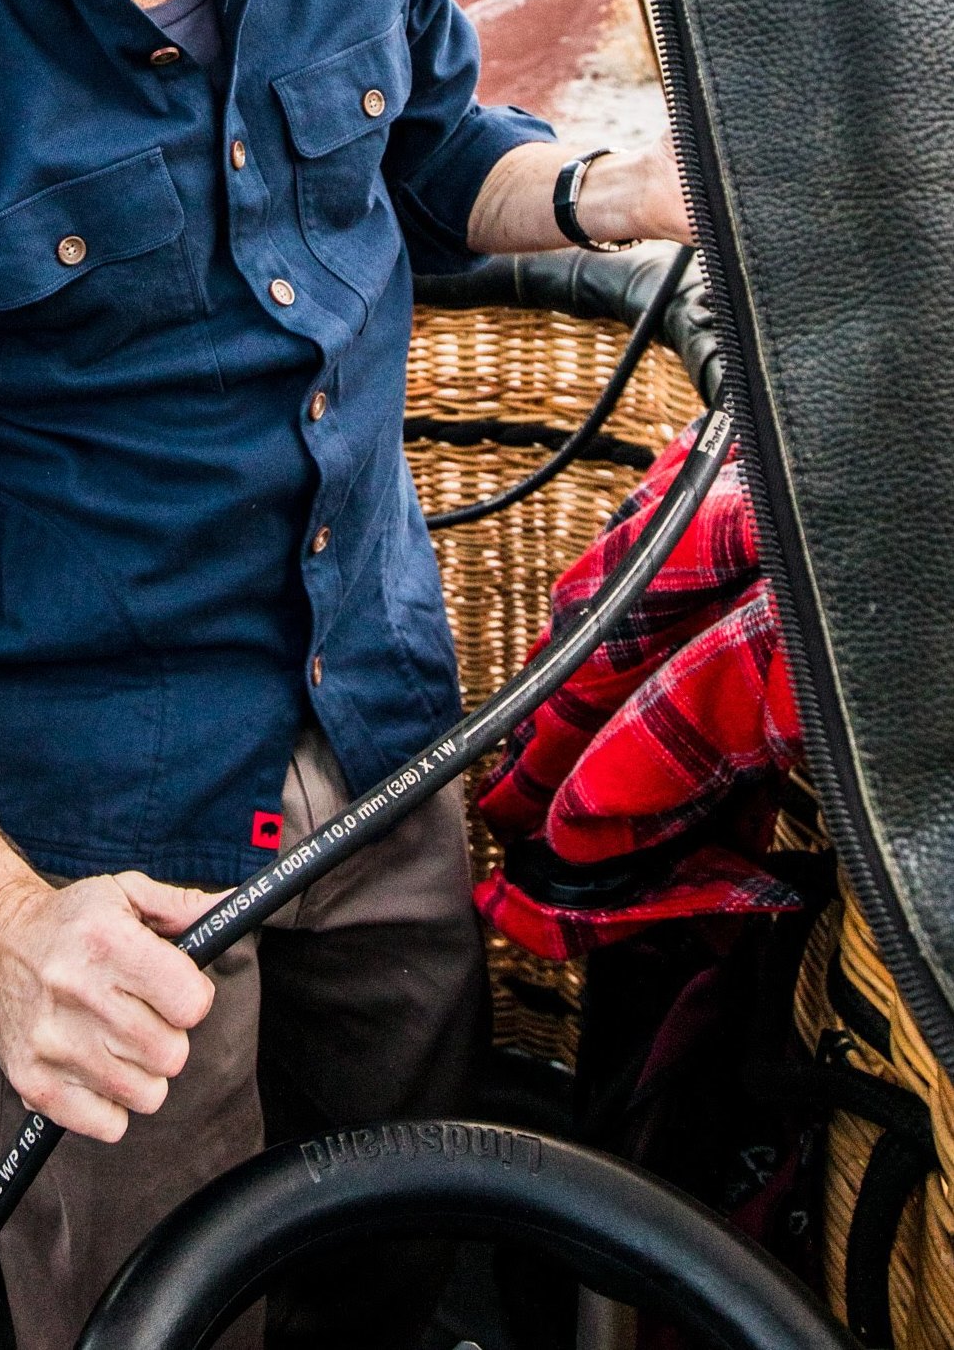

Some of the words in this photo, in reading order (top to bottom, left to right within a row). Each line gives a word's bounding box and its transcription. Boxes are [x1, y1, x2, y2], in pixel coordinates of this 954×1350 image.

[273, 839, 322, 881] 100R1
[323, 815, 357, 844] 10,0
[357, 794, 388, 820] mm
[387, 768, 421, 798] (3/8)
[432, 739, 457, 763] 1W
[0, 1149, 19, 1181] WP
[19, 1115, 45, 1152] 18,0
[300, 1122, 542, 1183] Lindstrand
